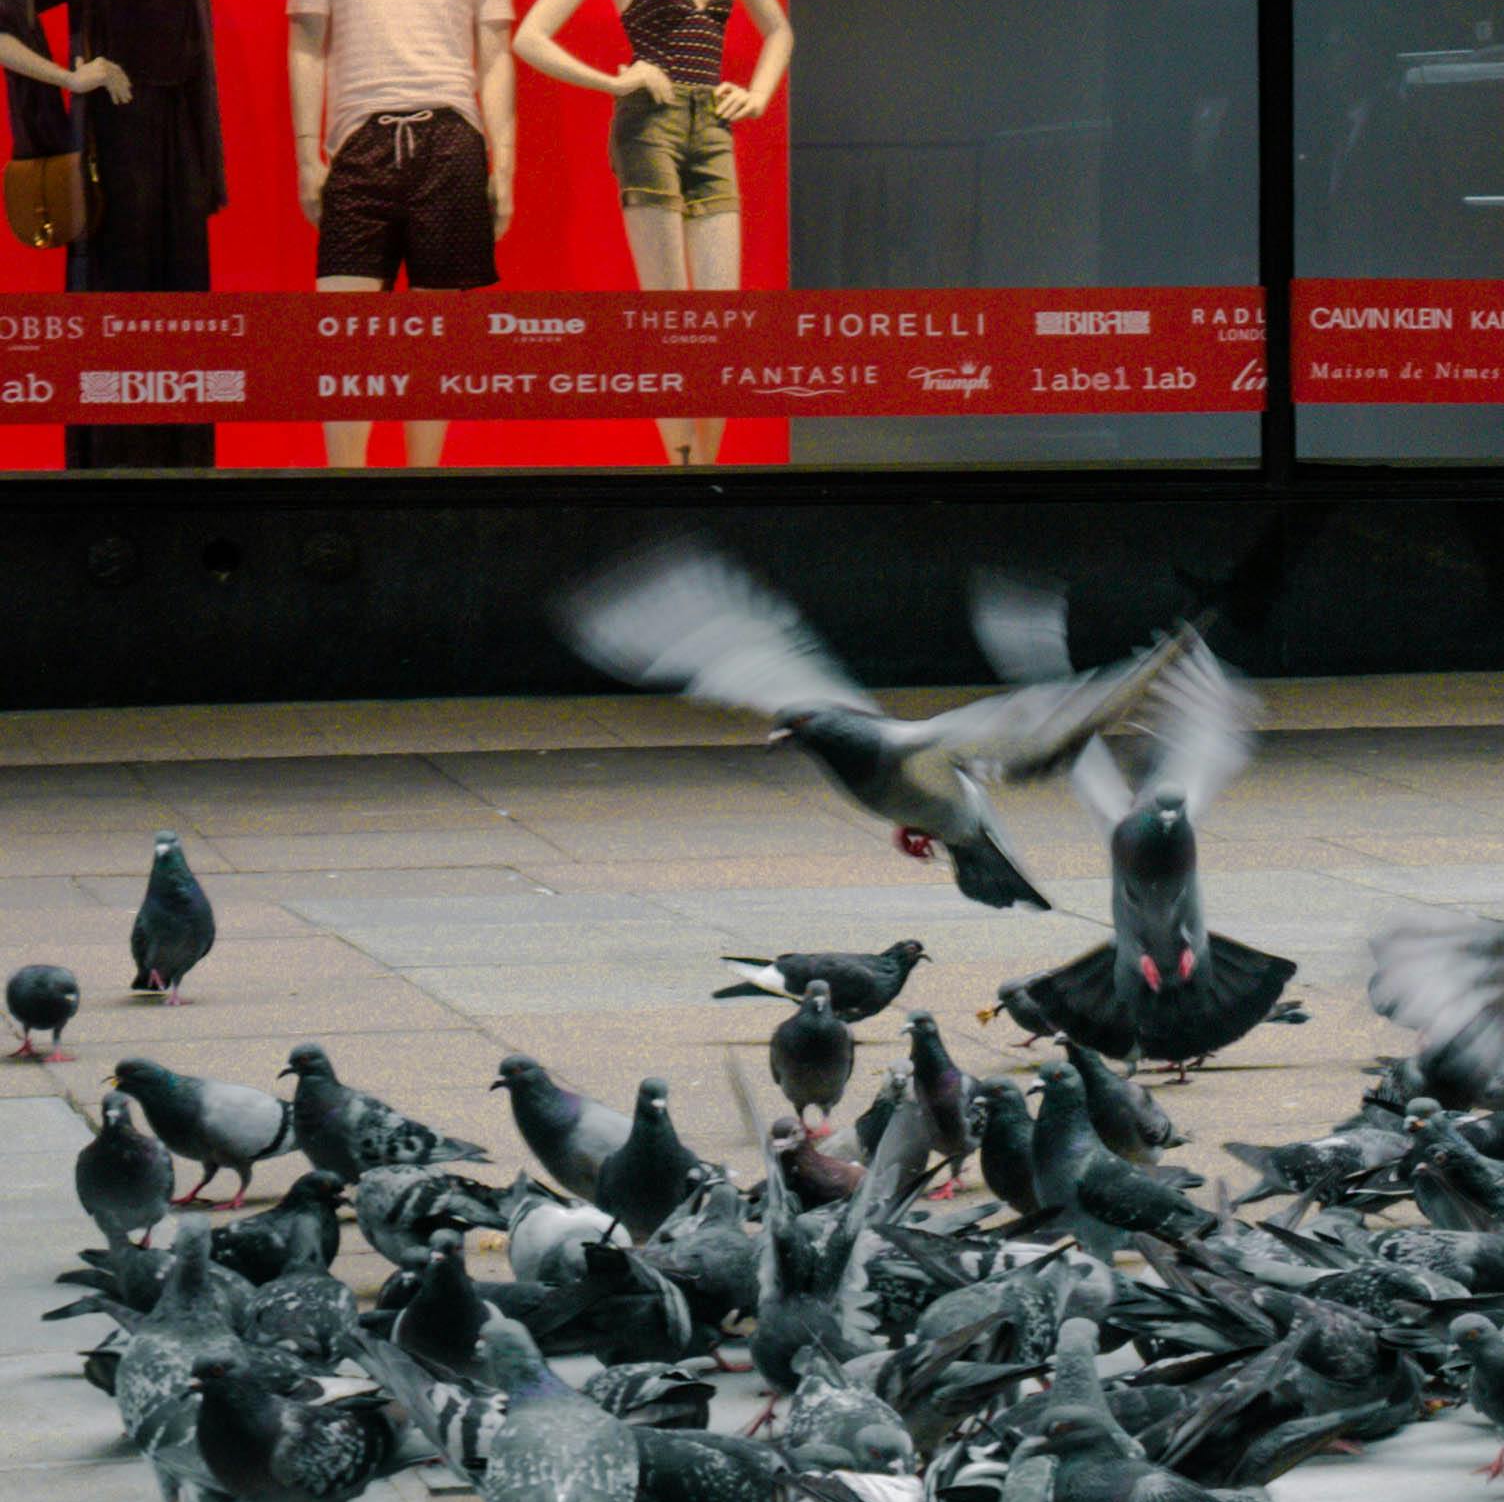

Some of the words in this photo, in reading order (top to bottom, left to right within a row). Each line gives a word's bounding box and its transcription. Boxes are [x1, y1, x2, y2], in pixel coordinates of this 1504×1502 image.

[317, 316, 445, 337] OFFICE
[487, 313, 586, 334] Dune
[622, 311, 757, 329] THERAPY
[797, 313, 985, 337] FIORELLI
[1309, 307, 1390, 329] CALVIN
[1393, 307, 1453, 329] KLEIN
[721, 366, 880, 385] FANTASIE
[907, 363, 992, 398] Triumph
[1031, 367, 1131, 391] label
[1142, 367, 1197, 390] lab
[1310, 361, 1390, 380] Maison
[1400, 361, 1424, 380] de
[318, 374, 411, 397] DKNY
[440, 374, 538, 395] KURT
[549, 373, 684, 394] GEIGER
